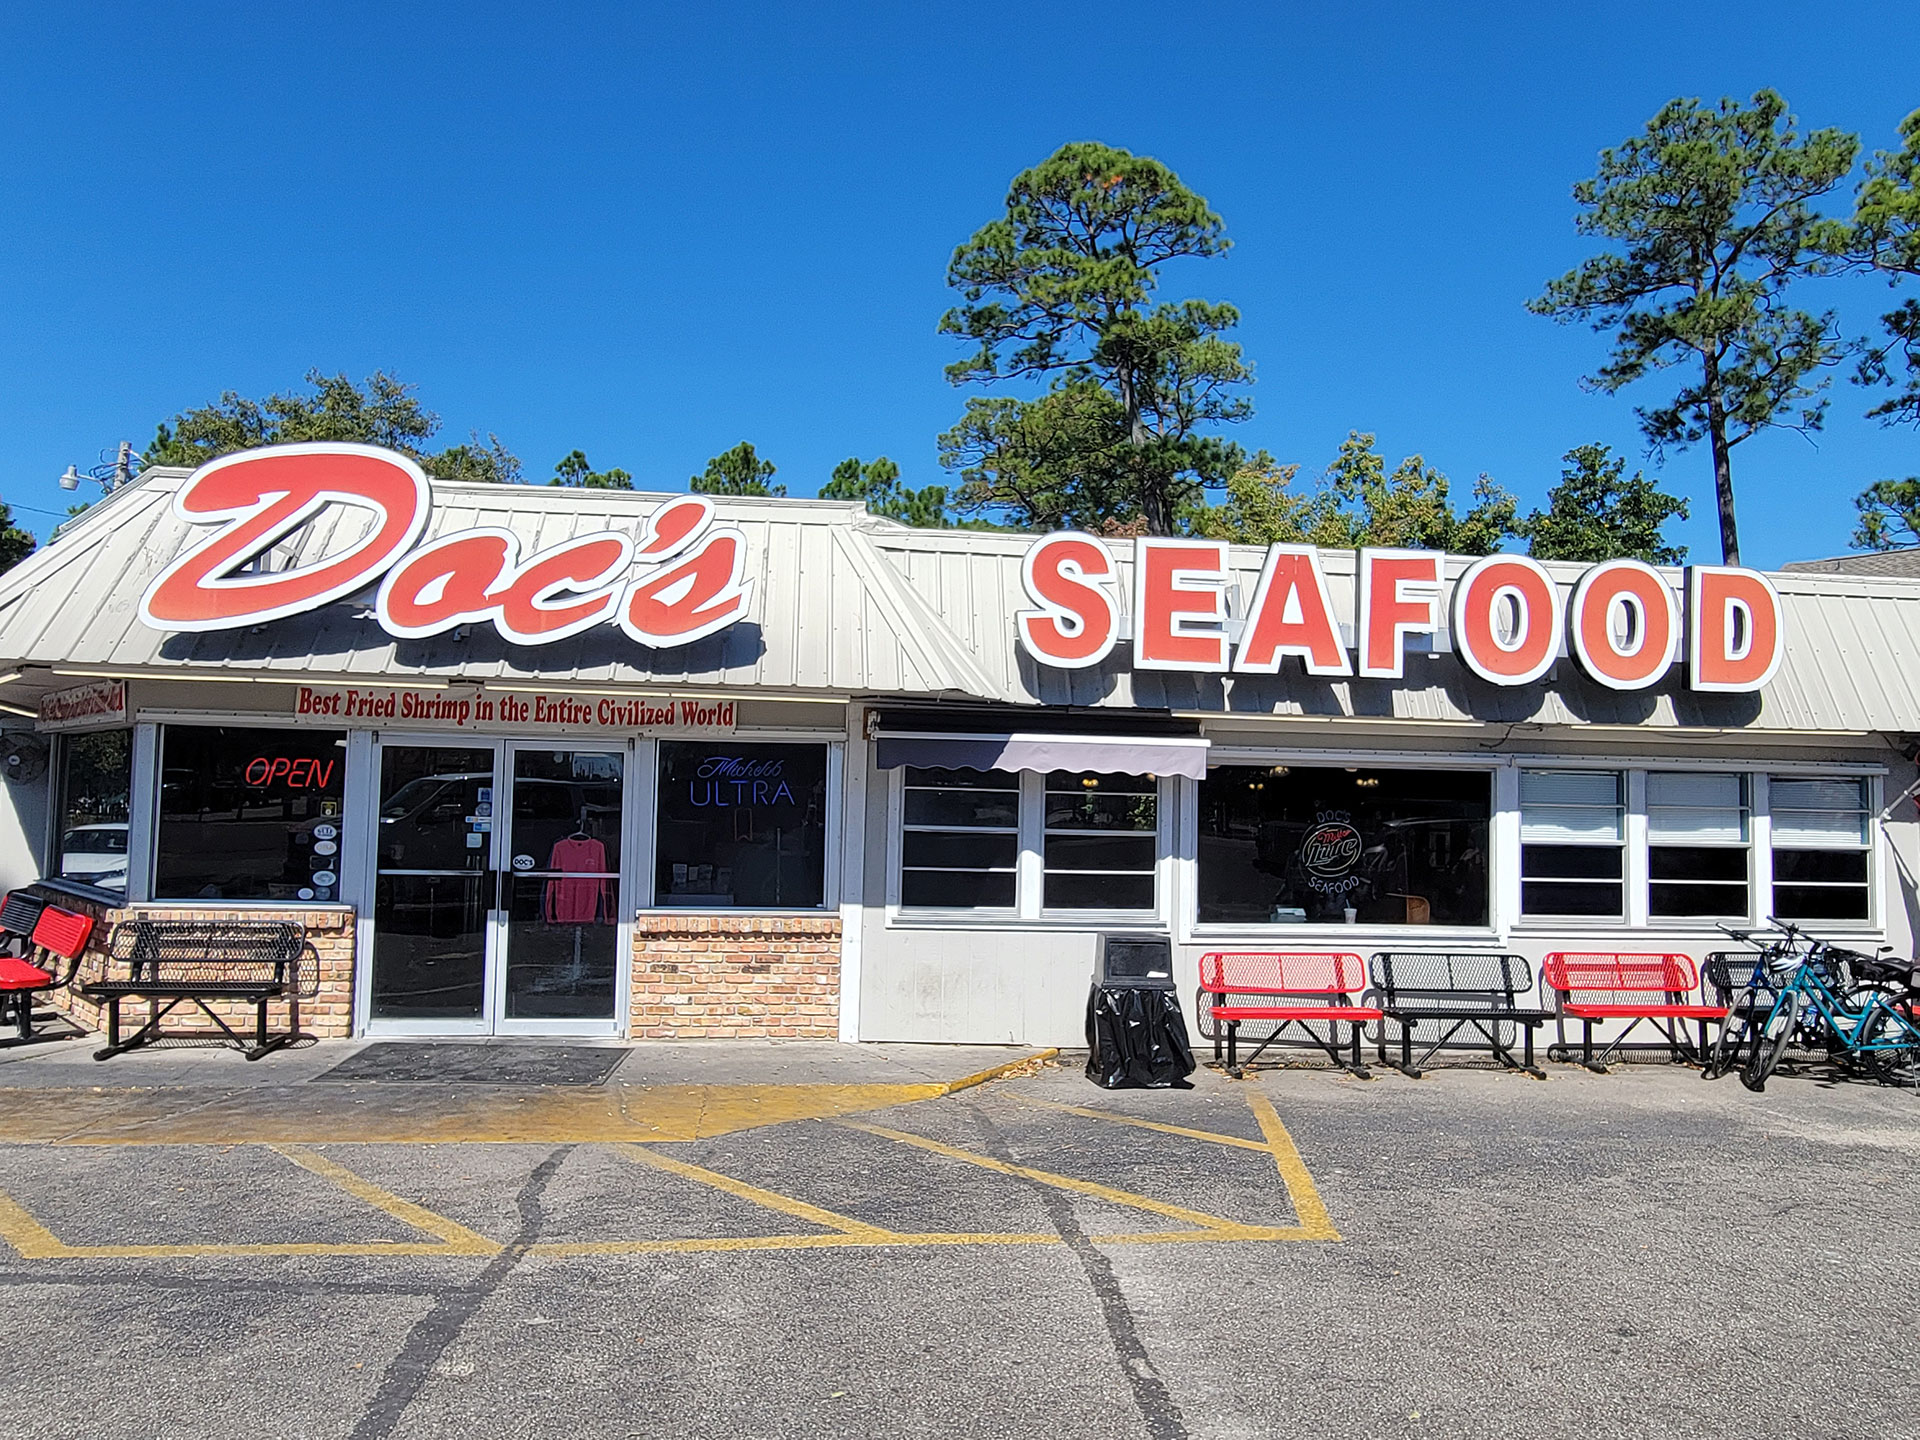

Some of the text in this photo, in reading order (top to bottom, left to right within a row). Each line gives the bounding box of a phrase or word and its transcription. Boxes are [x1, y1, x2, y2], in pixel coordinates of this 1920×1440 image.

[138, 442, 754, 648] Doc's
[1017, 531, 1783, 693] SEAFOOD
[298, 687, 734, 726] Best Fried Shrimp in the Entire Civilized World
[245, 757, 334, 789] OPEN
[690, 780, 796, 807] ULTRA
[1316, 809, 1351, 824] DOC'S
[514, 858, 533, 866] DOC'S
[1308, 875, 1360, 894] SEAFOOD
